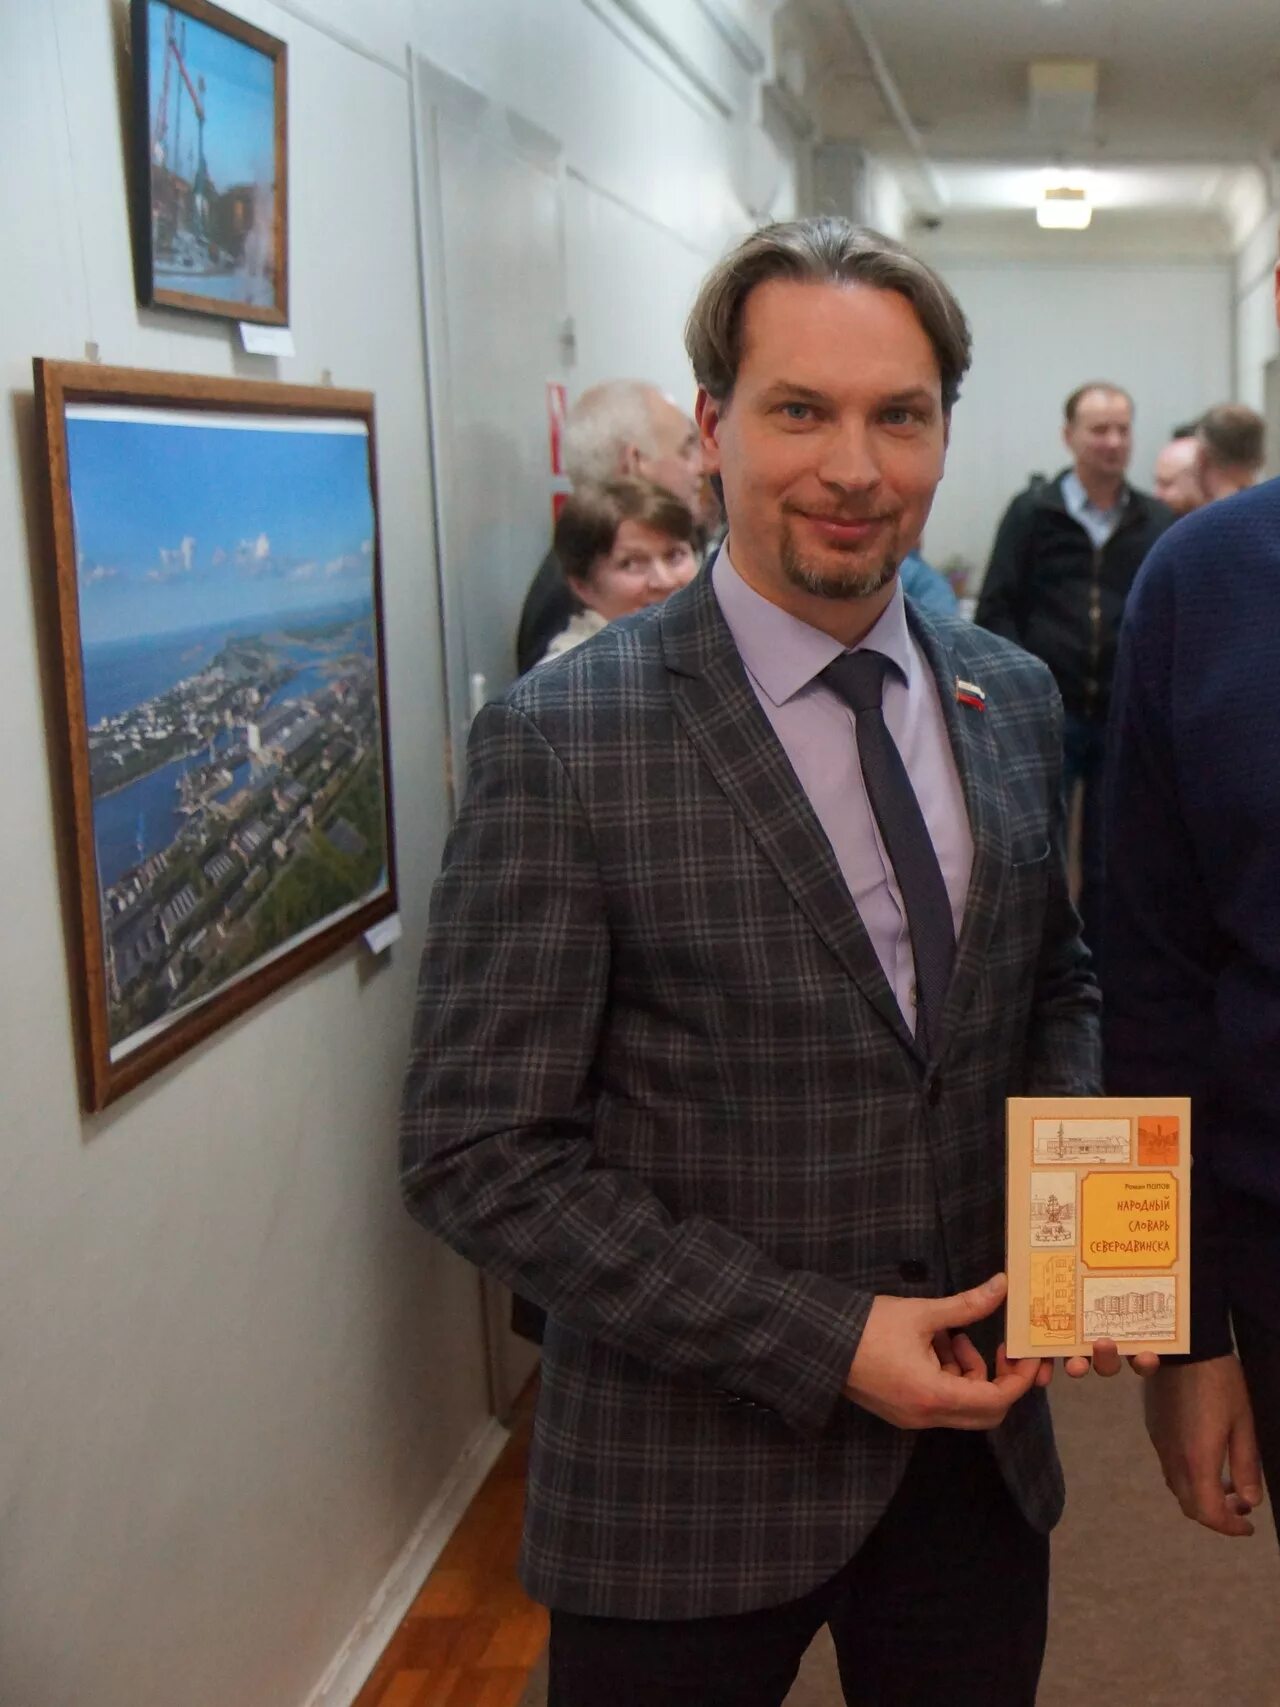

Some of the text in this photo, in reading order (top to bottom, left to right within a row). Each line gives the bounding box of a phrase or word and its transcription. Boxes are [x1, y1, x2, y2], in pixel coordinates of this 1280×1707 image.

[1117, 1195, 1170, 1211] НАРОДНЫЙ
[1128, 1219, 1170, 1232] СЛОВАРЬ
[1089, 1240, 1170, 1253] СЕВЕРОДВИНСКА
